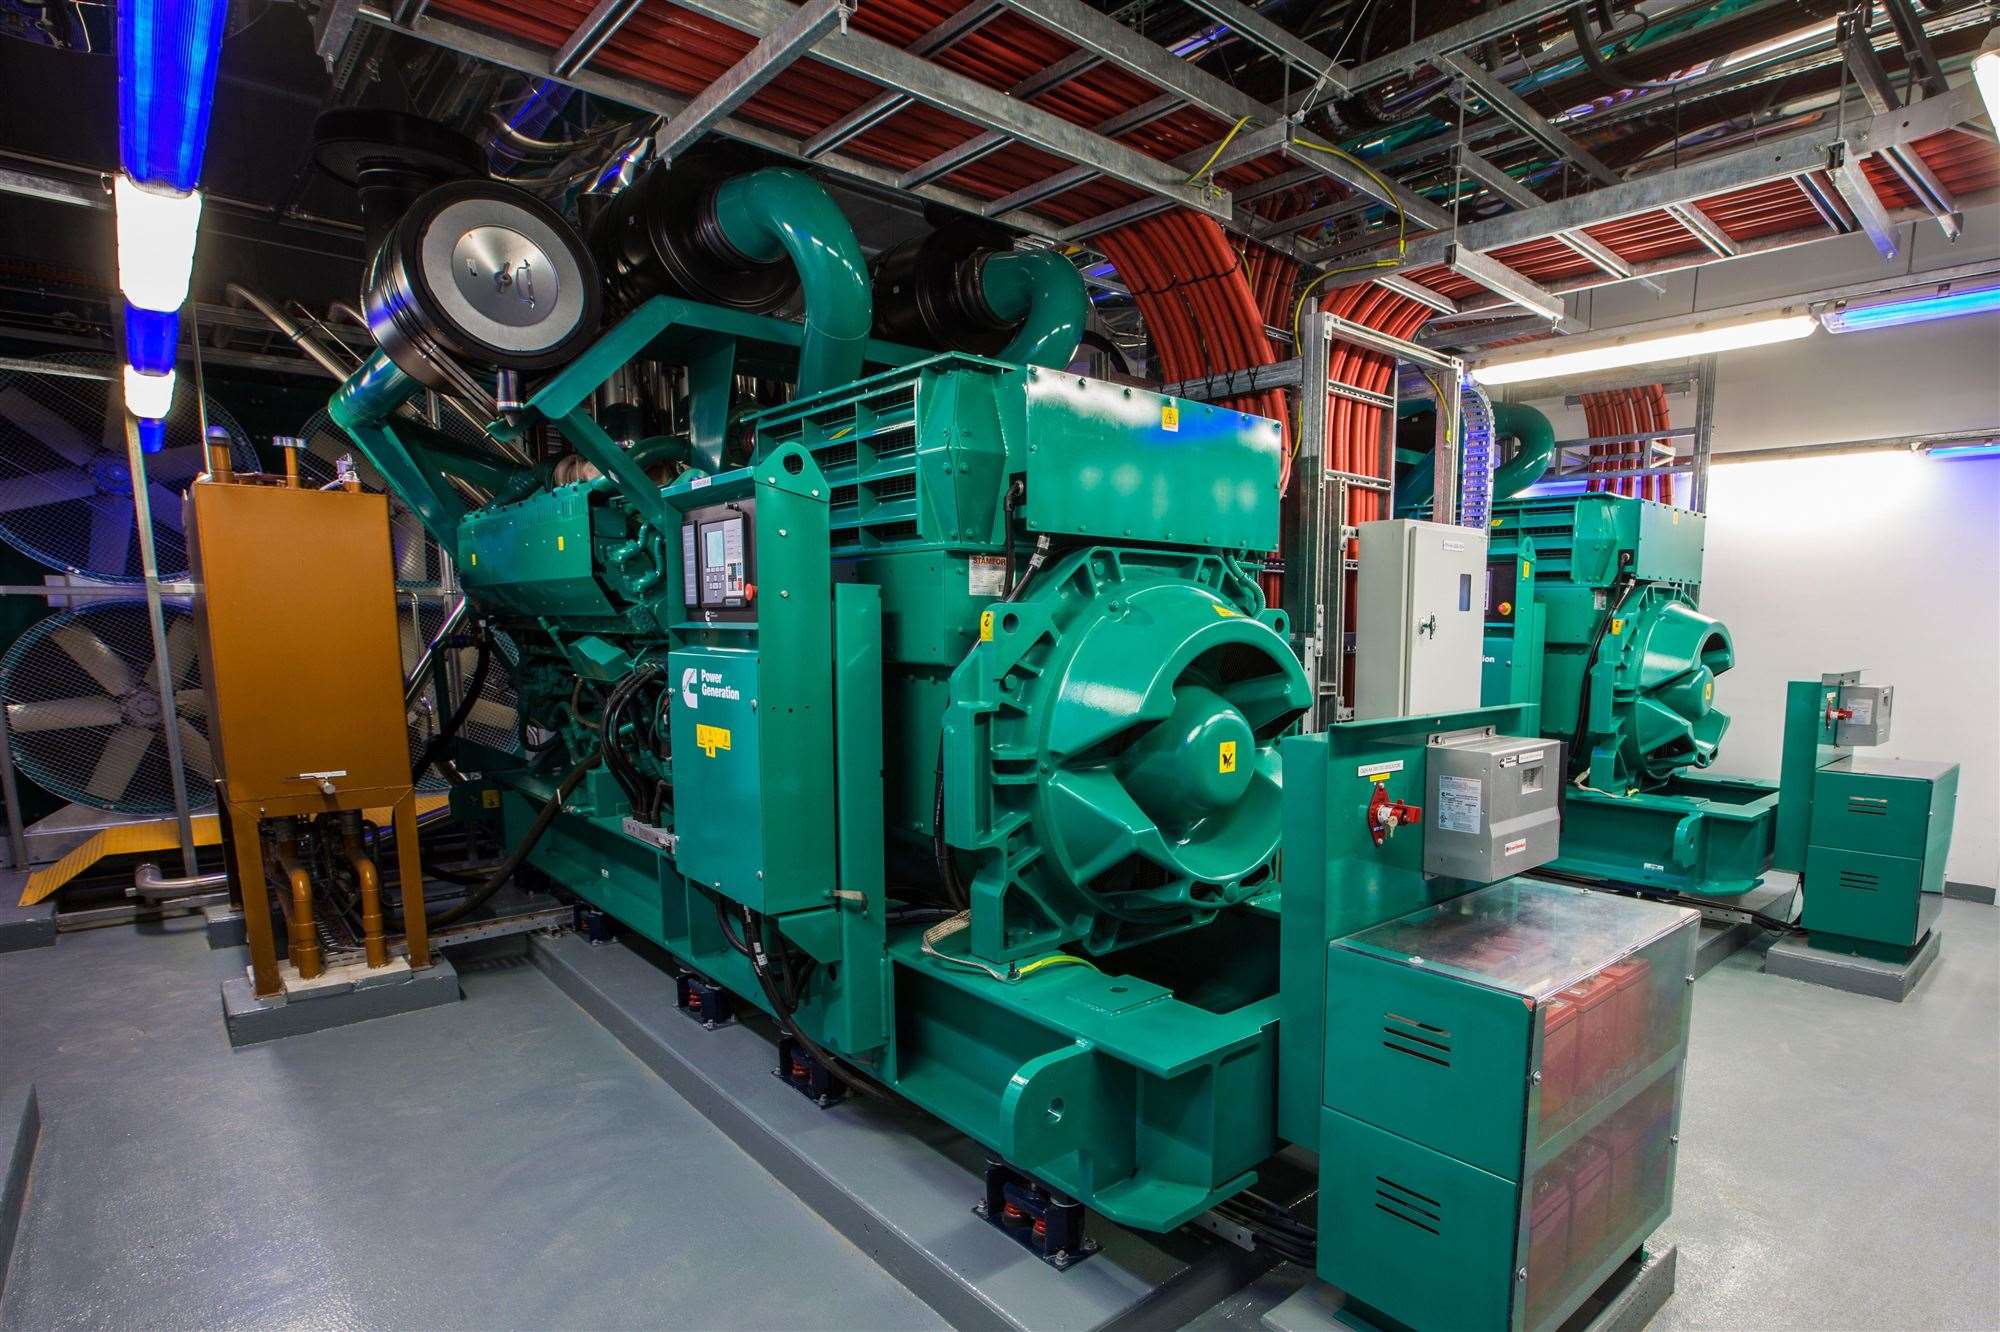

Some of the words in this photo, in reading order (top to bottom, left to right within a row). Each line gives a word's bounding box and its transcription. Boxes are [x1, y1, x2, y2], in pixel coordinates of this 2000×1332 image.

[973, 555, 1007, 566] STAMFOR
[701, 669, 722, 684] Power
[701, 683, 740, 701] Generation
